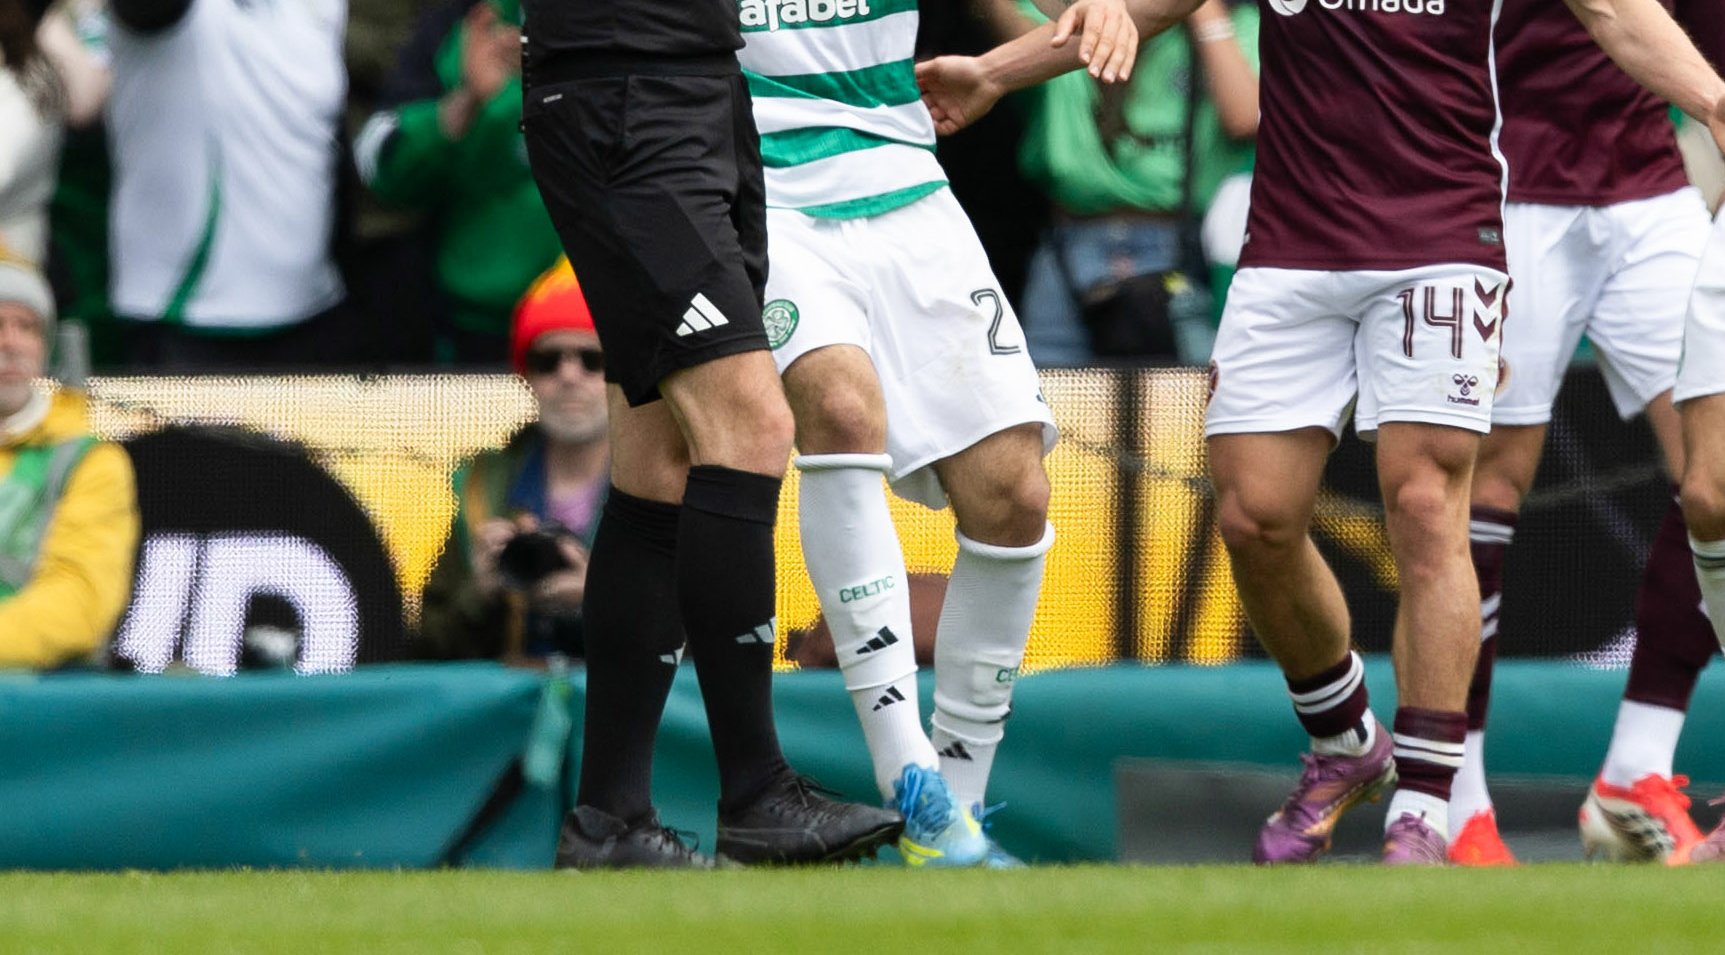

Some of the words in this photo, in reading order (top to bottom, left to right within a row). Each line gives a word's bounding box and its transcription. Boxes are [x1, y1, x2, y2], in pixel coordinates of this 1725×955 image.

[970, 288, 1021, 355] 2
[1396, 286, 1463, 359] 14
[839, 575, 895, 604] CELTIC
